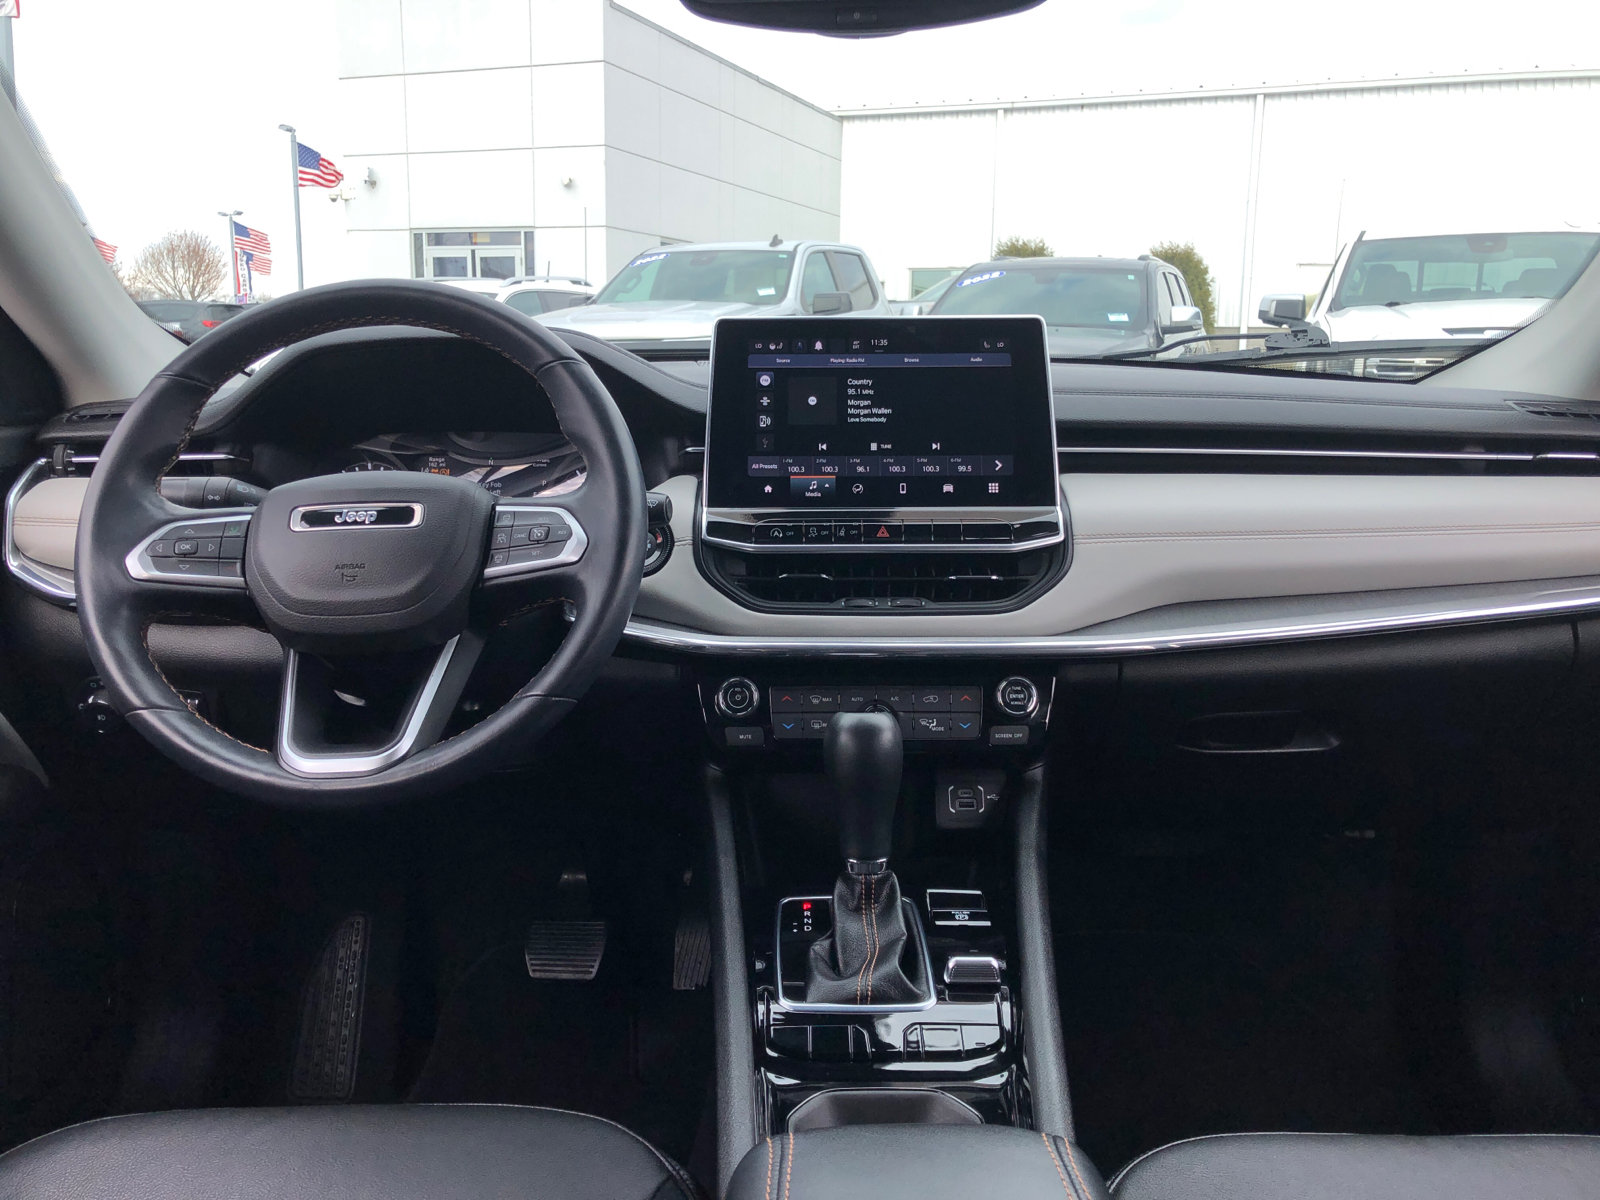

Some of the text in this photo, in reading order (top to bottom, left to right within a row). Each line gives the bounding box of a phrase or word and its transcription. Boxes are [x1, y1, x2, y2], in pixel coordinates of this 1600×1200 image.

[847, 378, 873, 386] Country
[847, 399, 872, 407] Morgan
[847, 408, 871, 416] Morgan
[334, 510, 377, 524] Jeep
[335, 563, 366, 571] AIRBAG
